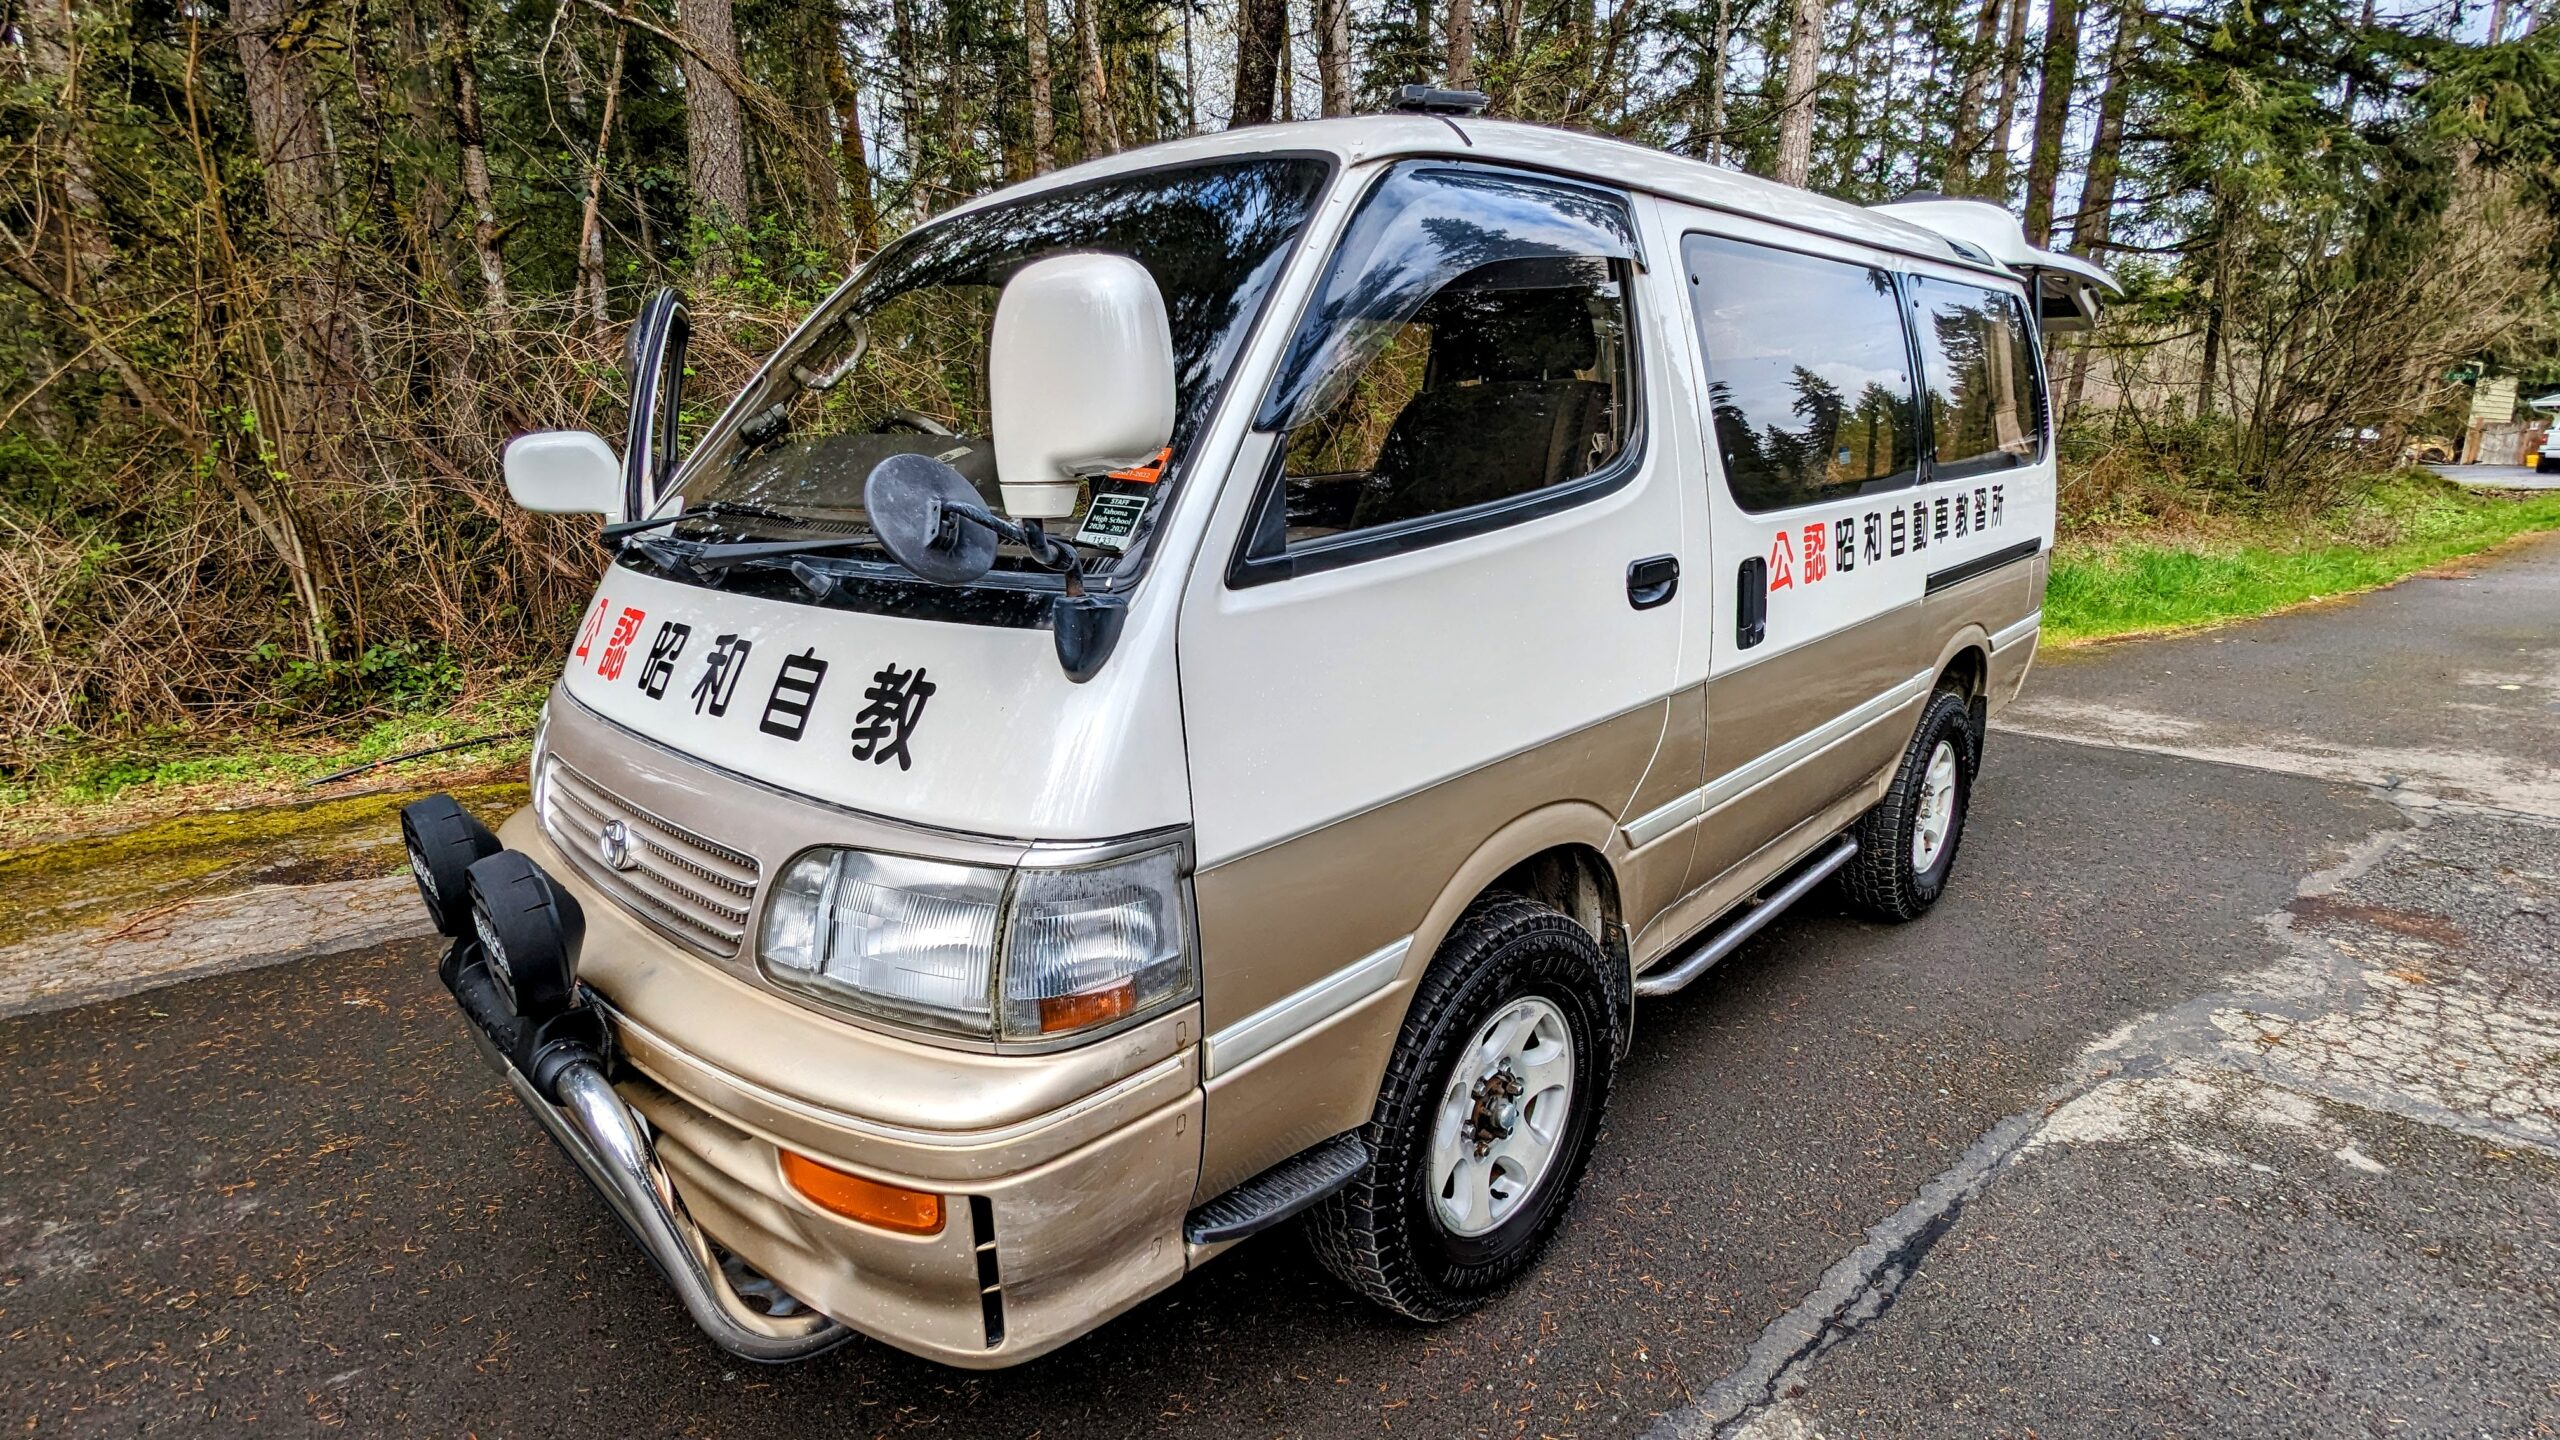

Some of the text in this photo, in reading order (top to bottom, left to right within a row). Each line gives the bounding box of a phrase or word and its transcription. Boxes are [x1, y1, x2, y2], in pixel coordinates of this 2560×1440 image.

[1110, 498, 1130, 506] STAFF
[1103, 507, 1128, 517] Tahoma
[1092, 514, 1132, 526] High School
[1088, 522, 1105, 531] 2020
[1110, 524, 1128, 533] 2021
